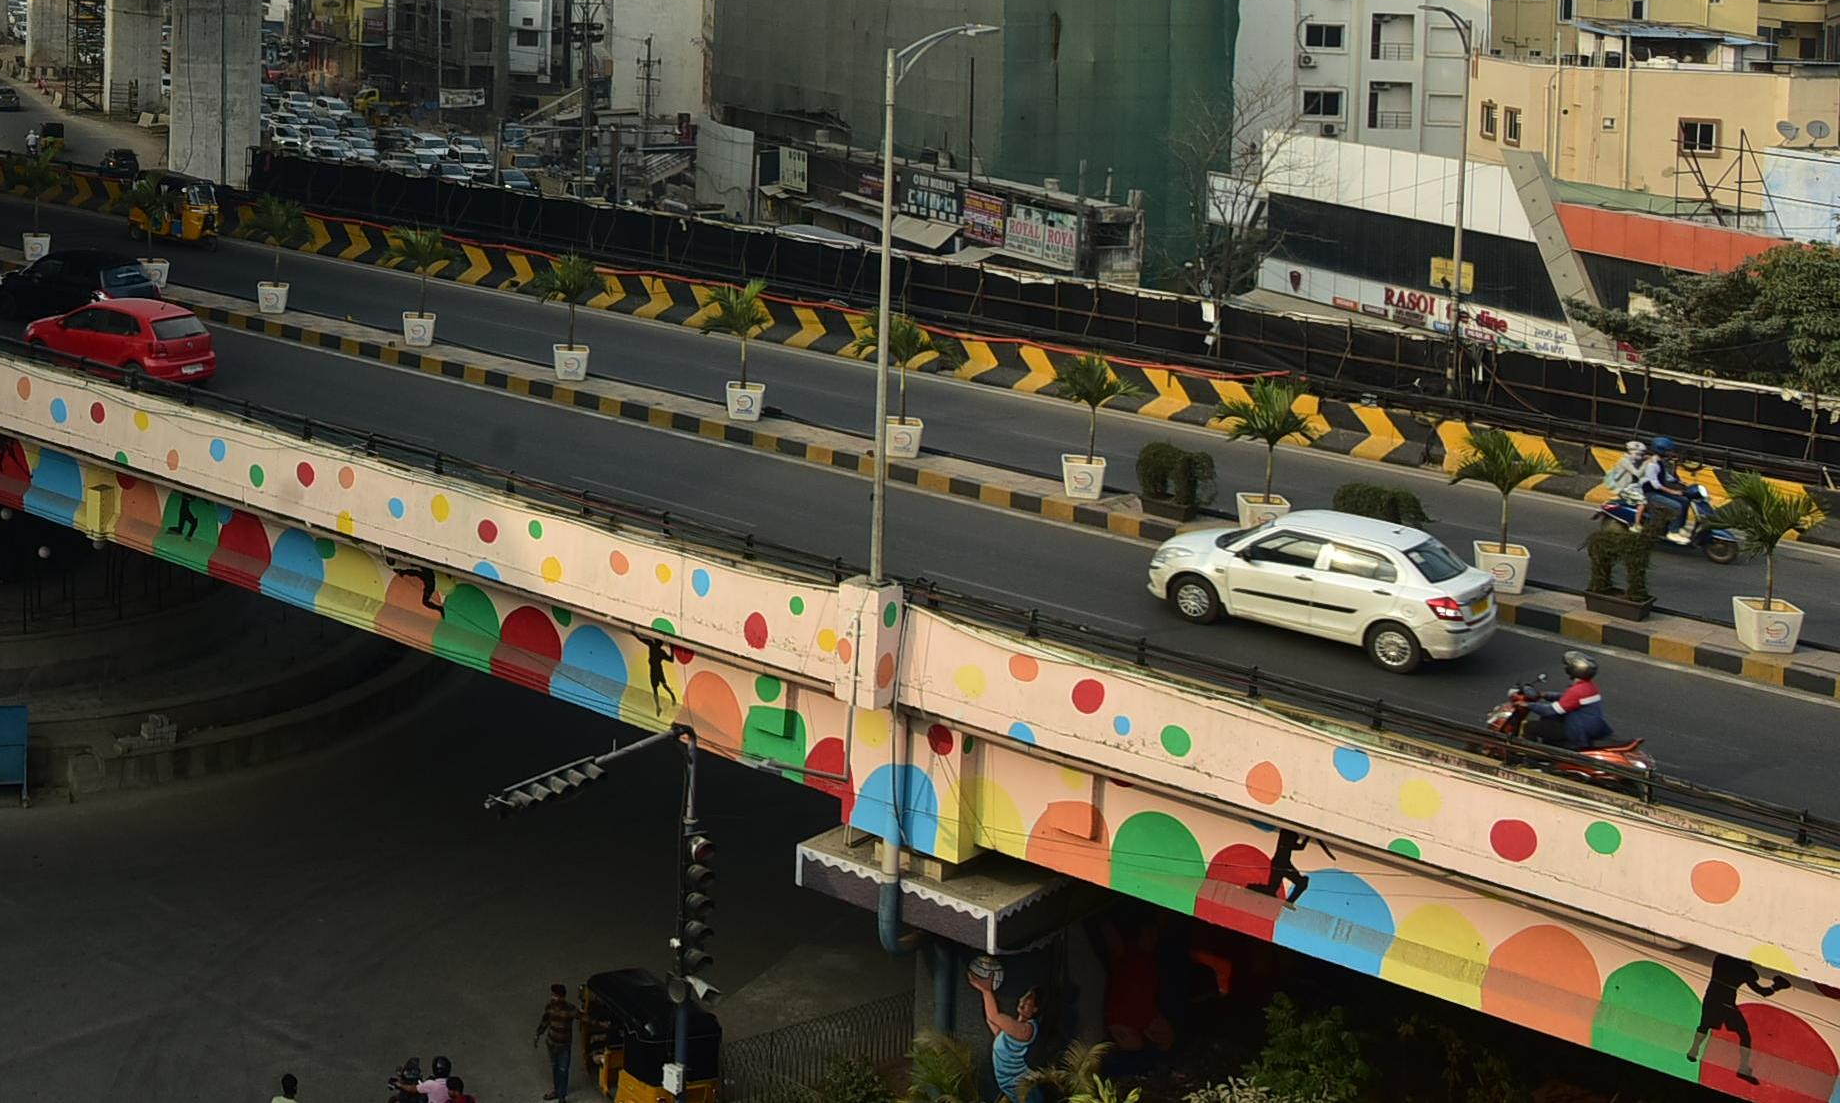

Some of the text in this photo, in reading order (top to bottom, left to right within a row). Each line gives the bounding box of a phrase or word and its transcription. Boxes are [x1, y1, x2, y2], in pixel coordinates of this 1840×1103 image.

[1009, 219, 1041, 239] ROYAL
[1047, 229, 1075, 248] ROYA
[1383, 287, 1436, 316] RASOI
[1475, 309, 1508, 333] dine
